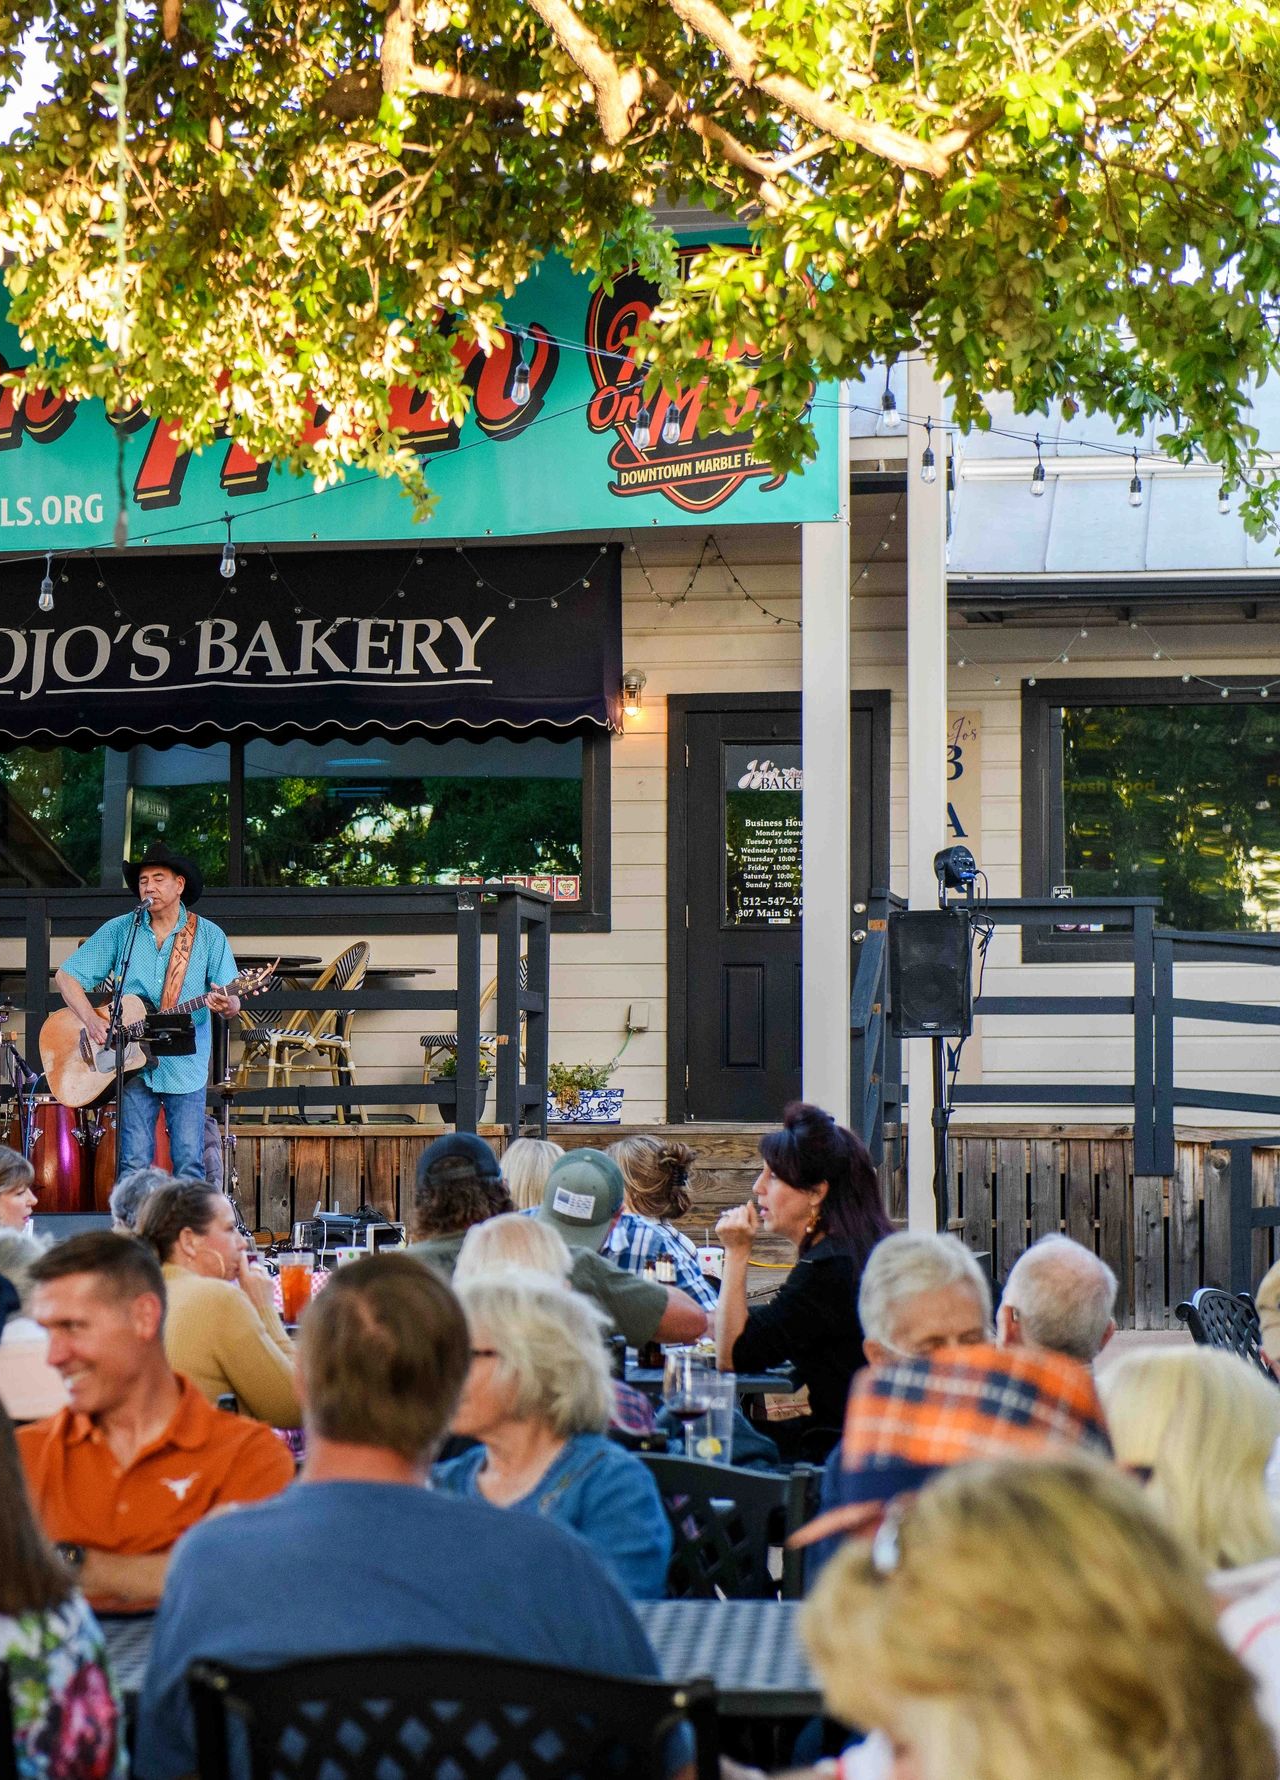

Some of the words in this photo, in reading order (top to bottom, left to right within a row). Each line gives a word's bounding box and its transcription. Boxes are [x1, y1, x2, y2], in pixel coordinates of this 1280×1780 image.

[620, 462, 692, 486] DOWNTOWN
[695, 454, 741, 474] MARBLE
[195, 616, 495, 677] BAKERY
[745, 819, 783, 827] Business
[755, 829, 782, 838] Monday
[746, 838, 772, 847] Tuesday
[741, 847, 778, 855] Wednesday
[742, 855, 774, 864] Thursday
[747, 864, 769, 872] Friday
[743, 872, 773, 881] Saturday
[745, 881, 770, 890] Sunday
[738, 909, 754, 917] 307
[757, 909, 780, 917] Main
[783, 908, 796, 917] St.
